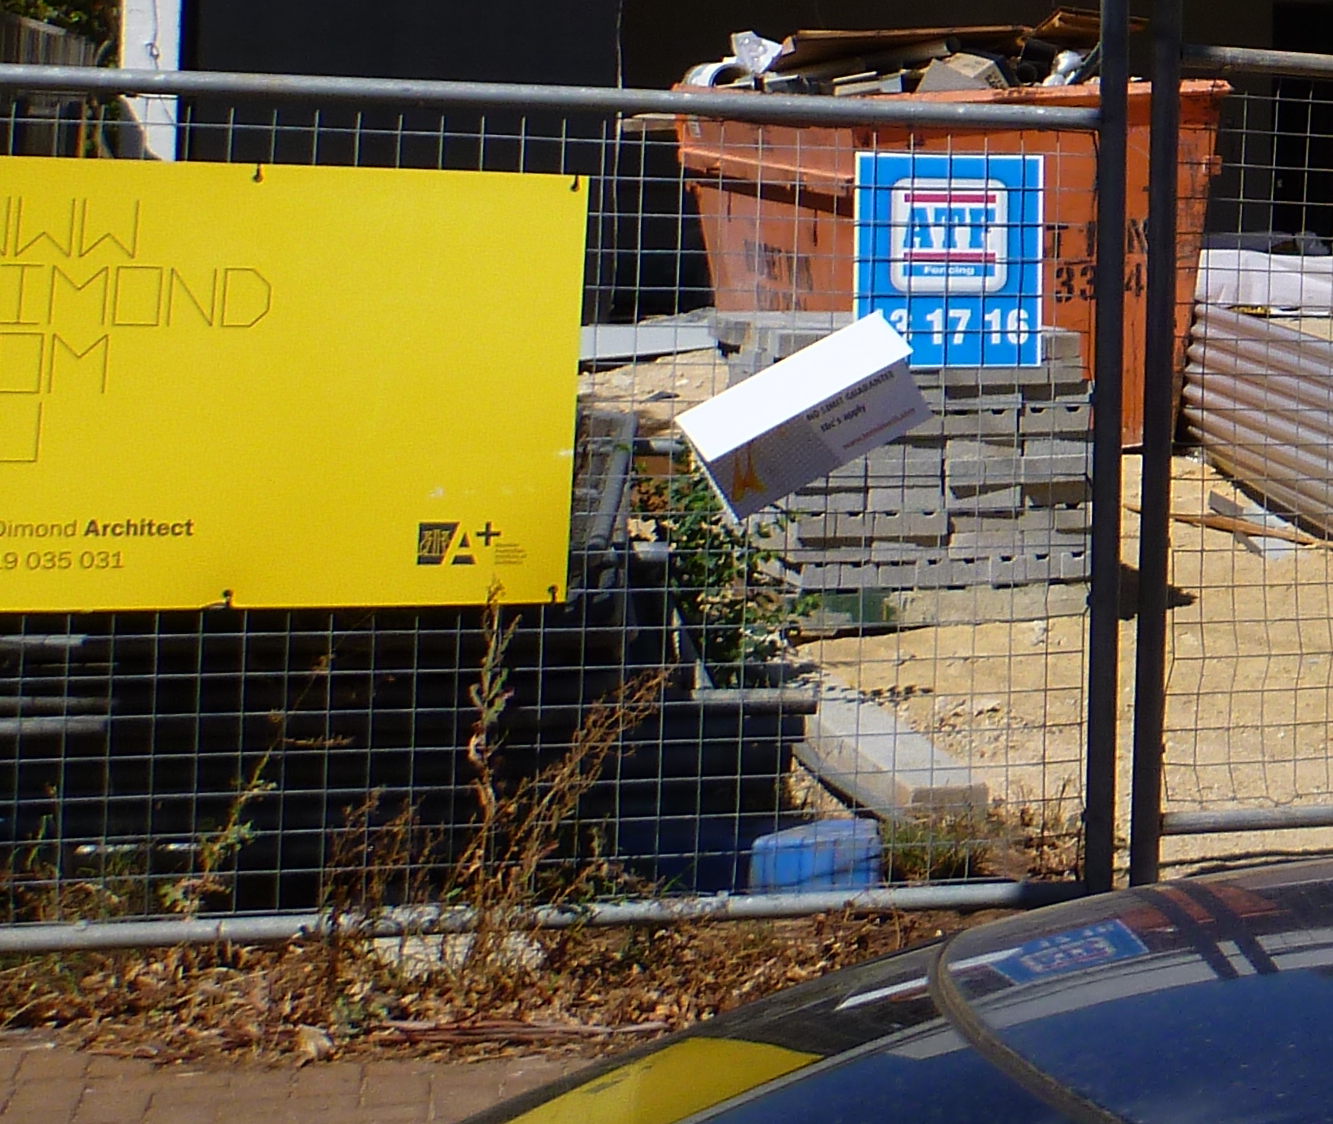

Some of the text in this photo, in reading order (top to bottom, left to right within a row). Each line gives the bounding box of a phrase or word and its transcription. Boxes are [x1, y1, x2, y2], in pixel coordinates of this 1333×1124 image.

[923, 265, 975, 276] Fencing
[926, 308, 971, 345] 17
[984, 308, 1029, 345] 16
[806, 410, 820, 421] NO
[83, 518, 195, 536] Architect
[27, 552, 72, 569] 035
[80, 551, 124, 568] 031
